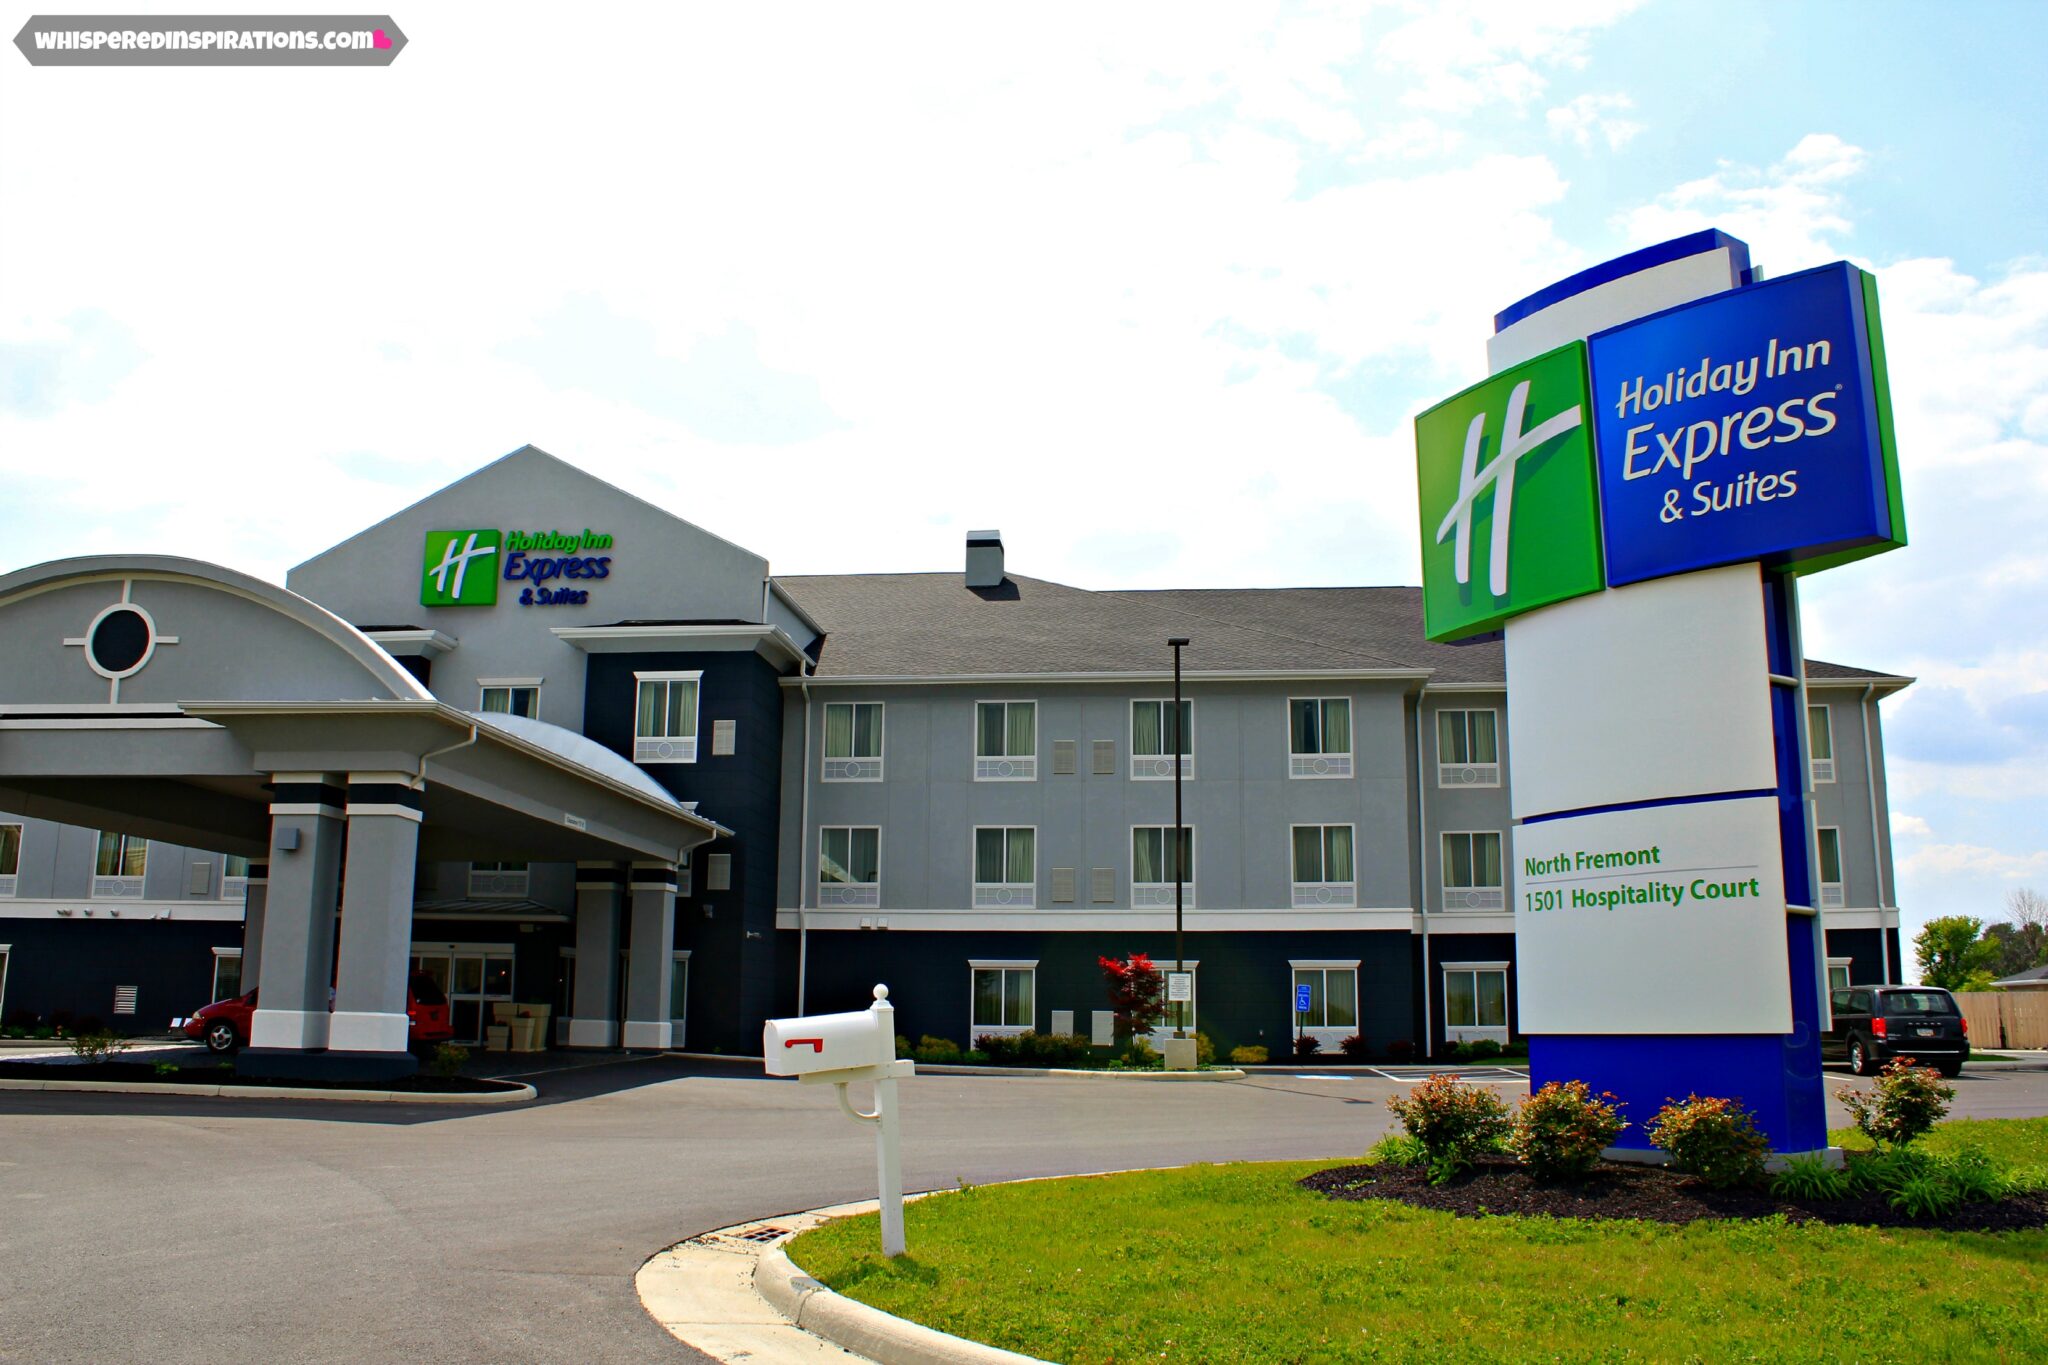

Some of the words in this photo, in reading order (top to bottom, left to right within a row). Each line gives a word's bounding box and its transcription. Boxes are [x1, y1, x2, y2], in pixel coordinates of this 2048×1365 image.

[1615, 357, 1759, 419] Holiday
[1766, 338, 1831, 378] Inn
[1659, 488, 1683, 523] &
[1691, 470, 1798, 516] Suites
[505, 530, 581, 554] Holiday
[581, 528, 613, 549] Inn
[503, 552, 611, 586] Express
[519, 588, 534, 605] &
[535, 587, 589, 605] Suites
[1525, 853, 1571, 877] North
[1575, 846, 1660, 871] Fremont
[1525, 889, 1564, 912] 1501
[1571, 882, 1684, 911] Hospitality
[1690, 878, 1760, 900] Court
